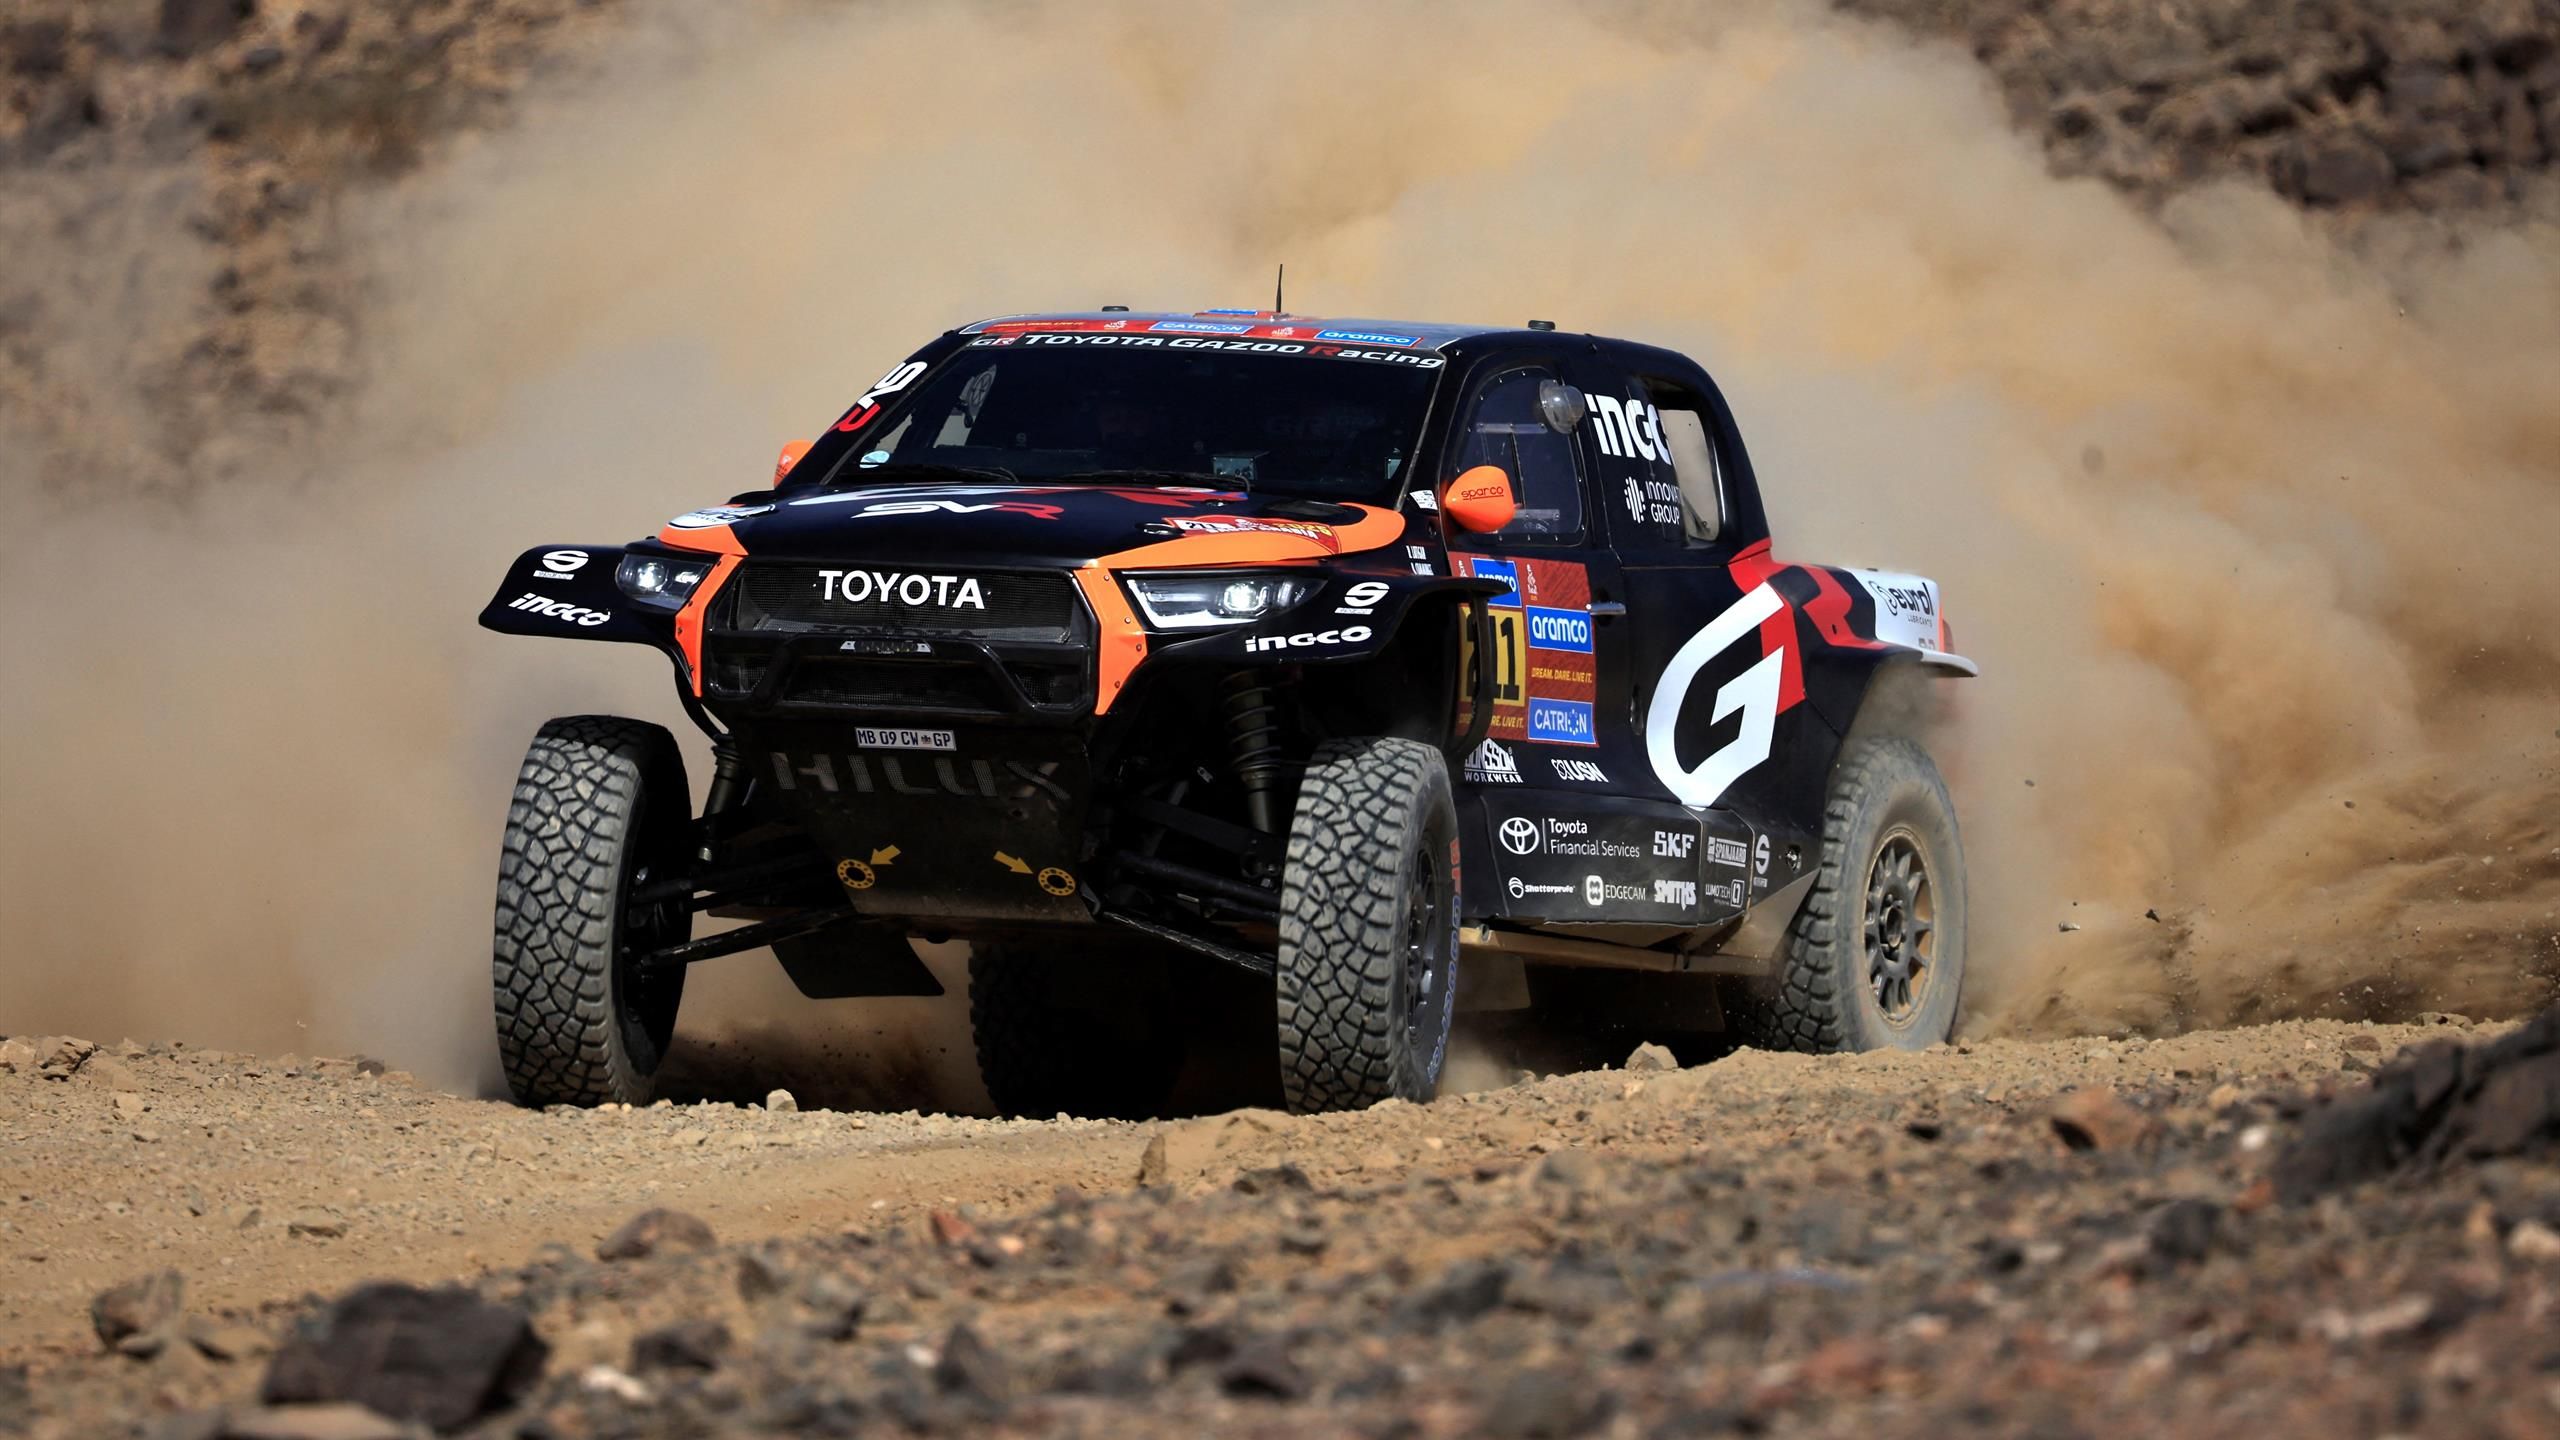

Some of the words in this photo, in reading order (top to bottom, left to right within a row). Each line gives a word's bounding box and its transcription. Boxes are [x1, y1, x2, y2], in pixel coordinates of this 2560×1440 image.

[1323, 330, 1411, 344] aramco
[1025, 333, 1165, 347] TOYOTA
[1168, 338, 1306, 354] GAZOO
[1308, 345, 1446, 369] Racing
[1461, 486, 1505, 500] sparco
[850, 500, 1064, 520] SVR
[1650, 503, 1680, 526] GROUP
[818, 569, 985, 610] TOYOTA
[1532, 615, 1588, 644] aramco
[857, 730, 876, 744] MB
[880, 731, 897, 745] 09
[901, 731, 919, 746] CW
[933, 733, 951, 747] GP
[770, 751, 1071, 800] HILUX
[1464, 772, 1524, 783] WORKWEAR
[1565, 760, 1609, 783] USN
[1548, 818, 1588, 837] Toyota
[1550, 839, 1599, 856] Financial
[1601, 841, 1640, 858] Services
[1653, 831, 1695, 858] SKF
[1605, 885, 1646, 900] EDGECAM
